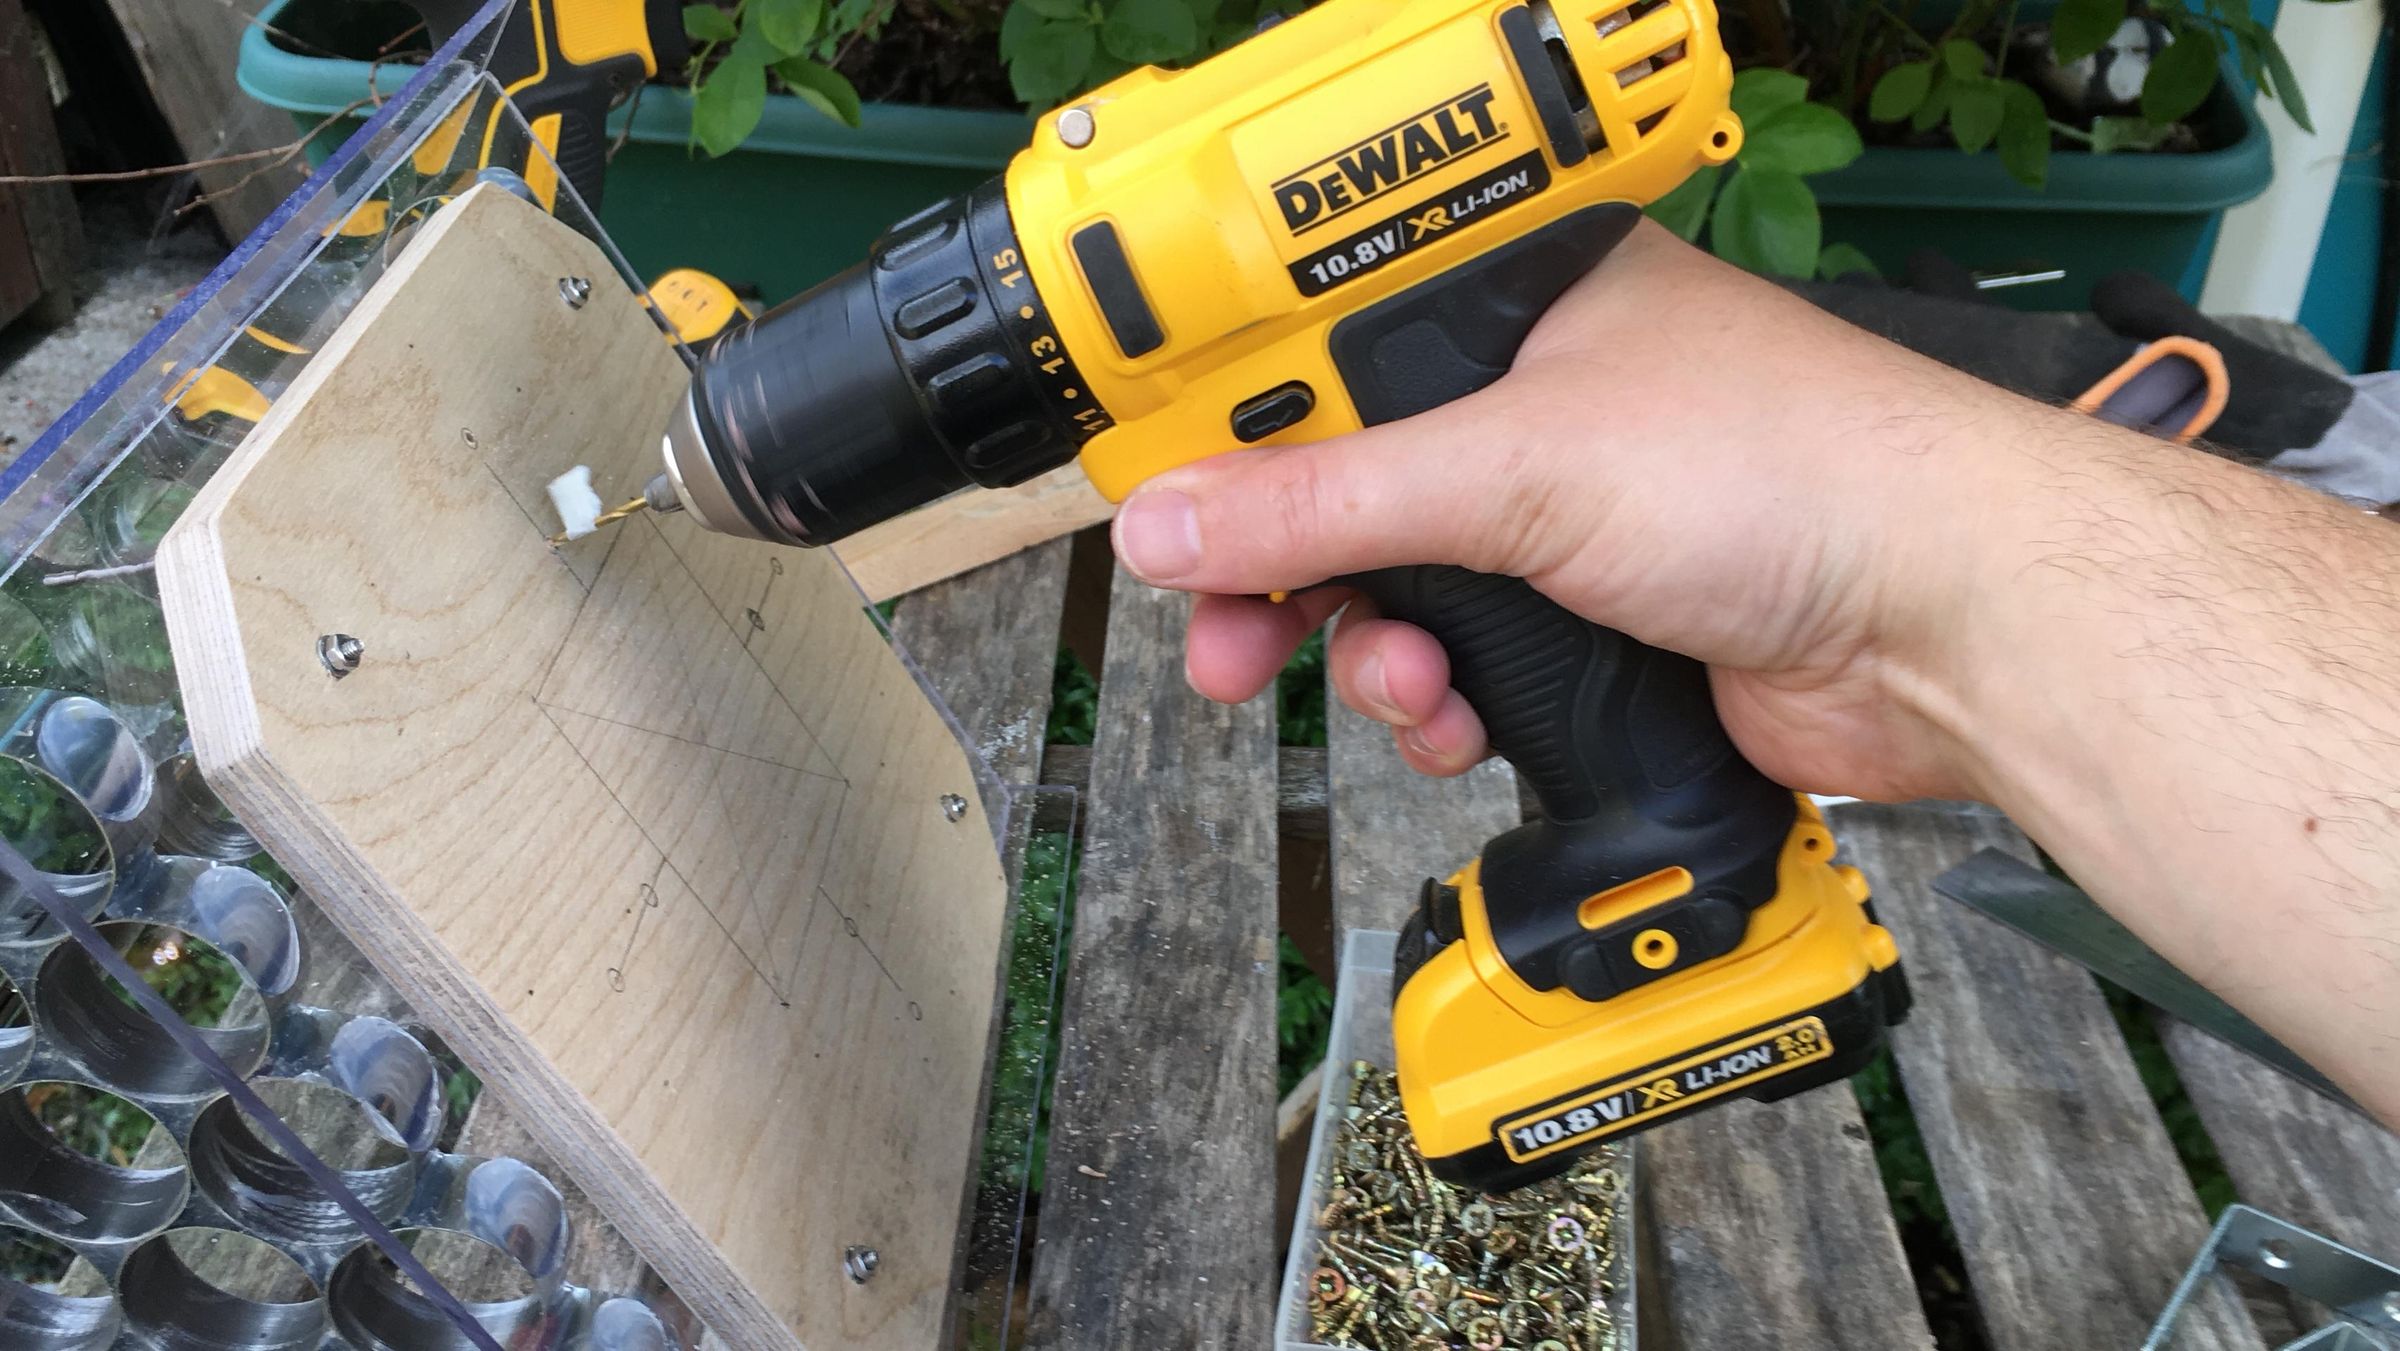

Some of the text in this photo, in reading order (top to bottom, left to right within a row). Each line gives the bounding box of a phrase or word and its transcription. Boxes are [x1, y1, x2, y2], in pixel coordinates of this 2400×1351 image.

[1308, 169, 1529, 285] 10.8V XR LI-ION
[992, 247, 1025, 289] 15
[1030, 335, 1066, 375] 13
[1514, 1045, 1772, 1151] 10.8V XR LI-ION
